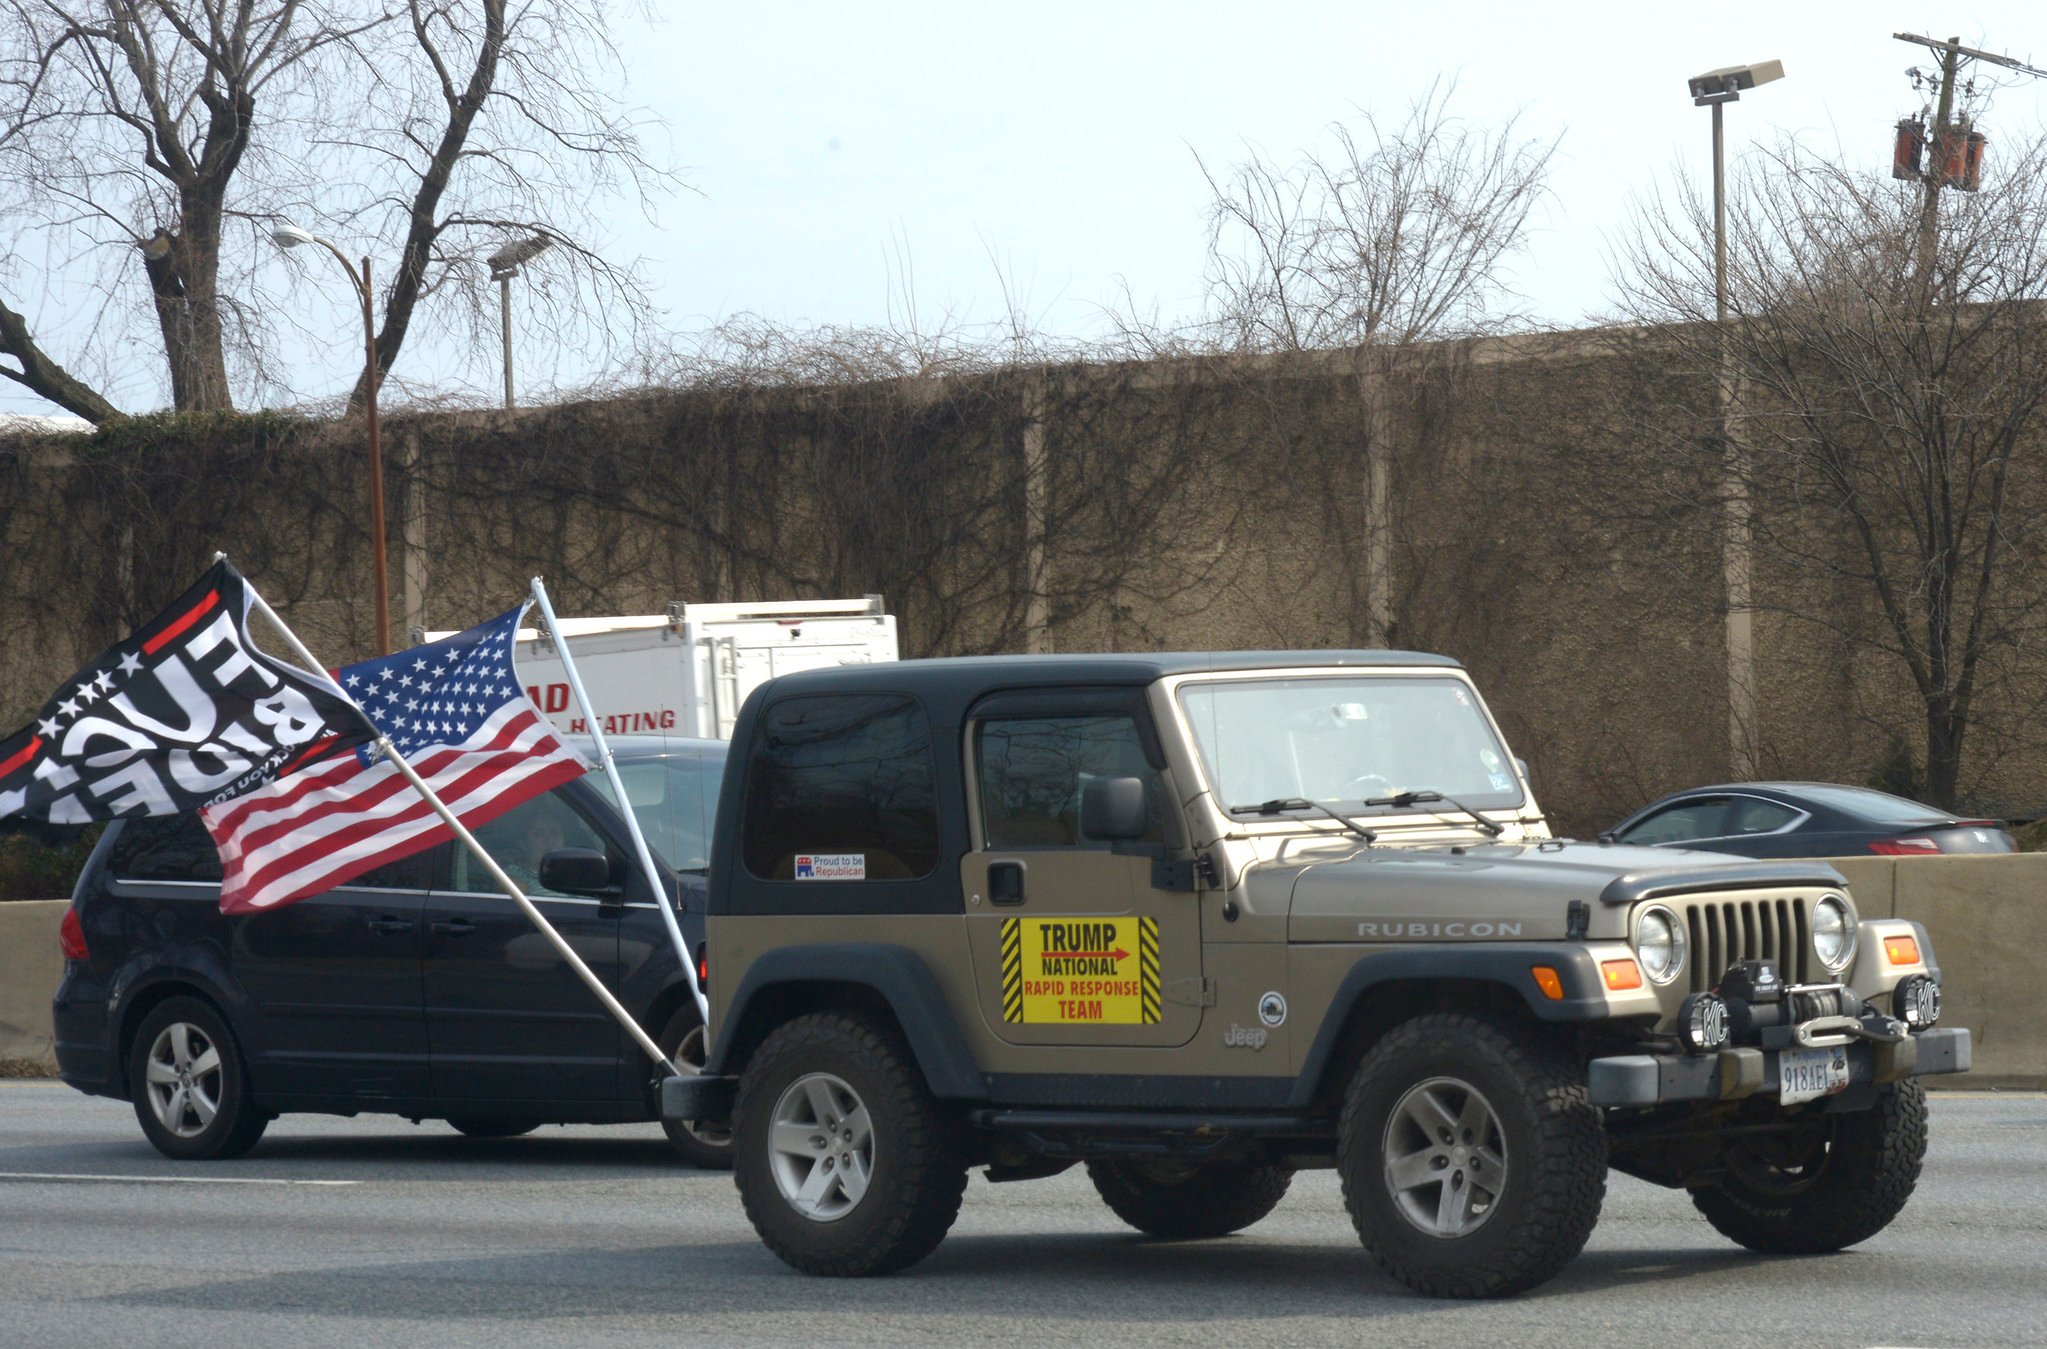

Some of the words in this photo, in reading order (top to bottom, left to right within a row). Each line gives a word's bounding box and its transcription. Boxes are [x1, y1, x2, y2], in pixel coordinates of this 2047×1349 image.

[814, 856, 840, 866] Proud
[842, 857, 850, 866] to
[853, 856, 863, 866] be
[816, 866, 864, 877] Republican
[1040, 923, 1117, 952] TRUMP
[1357, 923, 1522, 937] RUBICON
[1042, 958, 1118, 976] NATIONAL
[1025, 981, 1064, 996] RAPID
[1071, 981, 1139, 996] RESPONSE
[1058, 1000, 1102, 1019] TEAM
[1918, 981, 1940, 1024] KC
[1703, 1001, 1728, 1046] KC
[1224, 1023, 1267, 1050] Jeep
